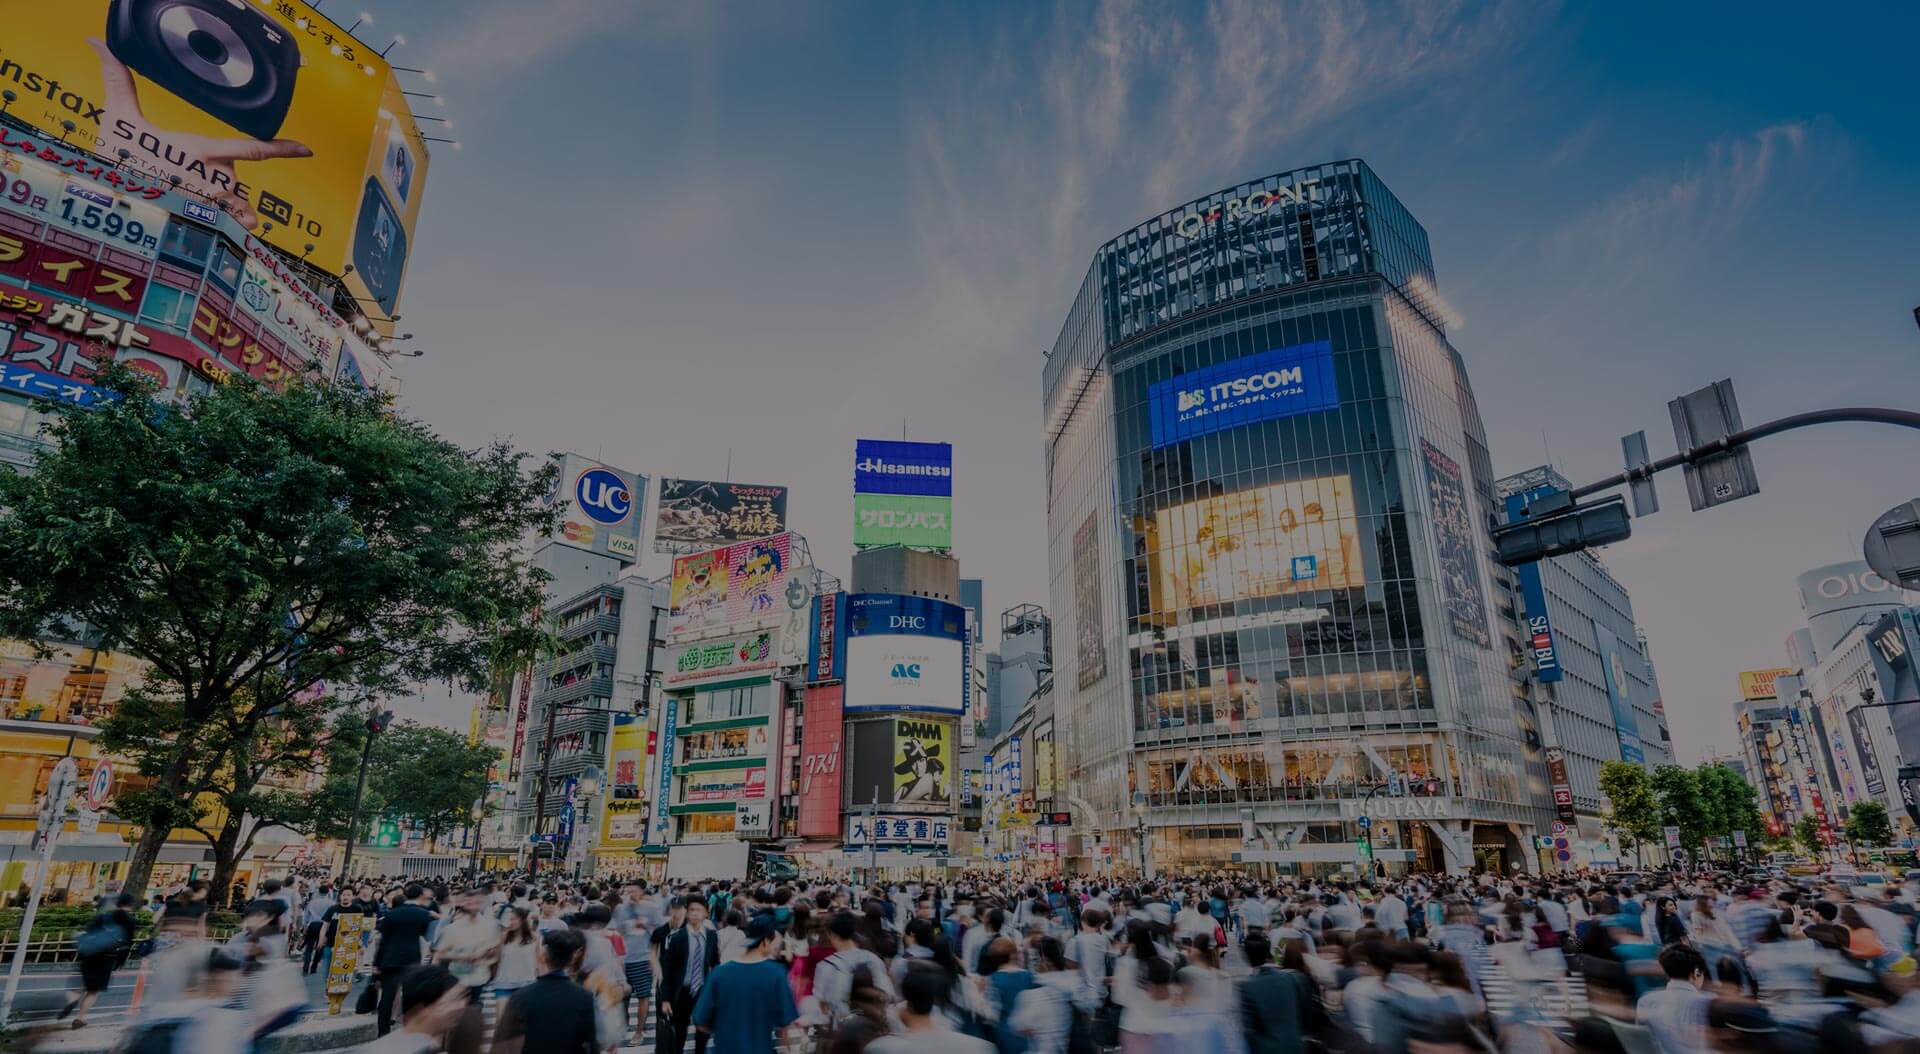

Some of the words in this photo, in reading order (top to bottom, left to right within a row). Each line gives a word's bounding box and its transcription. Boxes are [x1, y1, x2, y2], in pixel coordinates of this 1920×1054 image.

[0, 58, 106, 127] nstax
[113, 119, 252, 201] SQUARE
[44, 111, 106, 147] HYRID
[185, 183, 245, 218] CAMRA
[61, 198, 157, 249] 1,599円
[47, 302, 151, 347] ガスト
[583, 477, 632, 514] UC
[860, 507, 947, 529] サロンパス
[612, 536, 634, 552] VISA
[1818, 571, 1892, 600] OIO
[889, 615, 926, 630] DHC
[1529, 615, 1555, 672] SEIBU
[898, 721, 942, 740] DMM
[1344, 801, 1449, 818] TSUTAYA
[854, 819, 948, 839] 大盛堂書店
